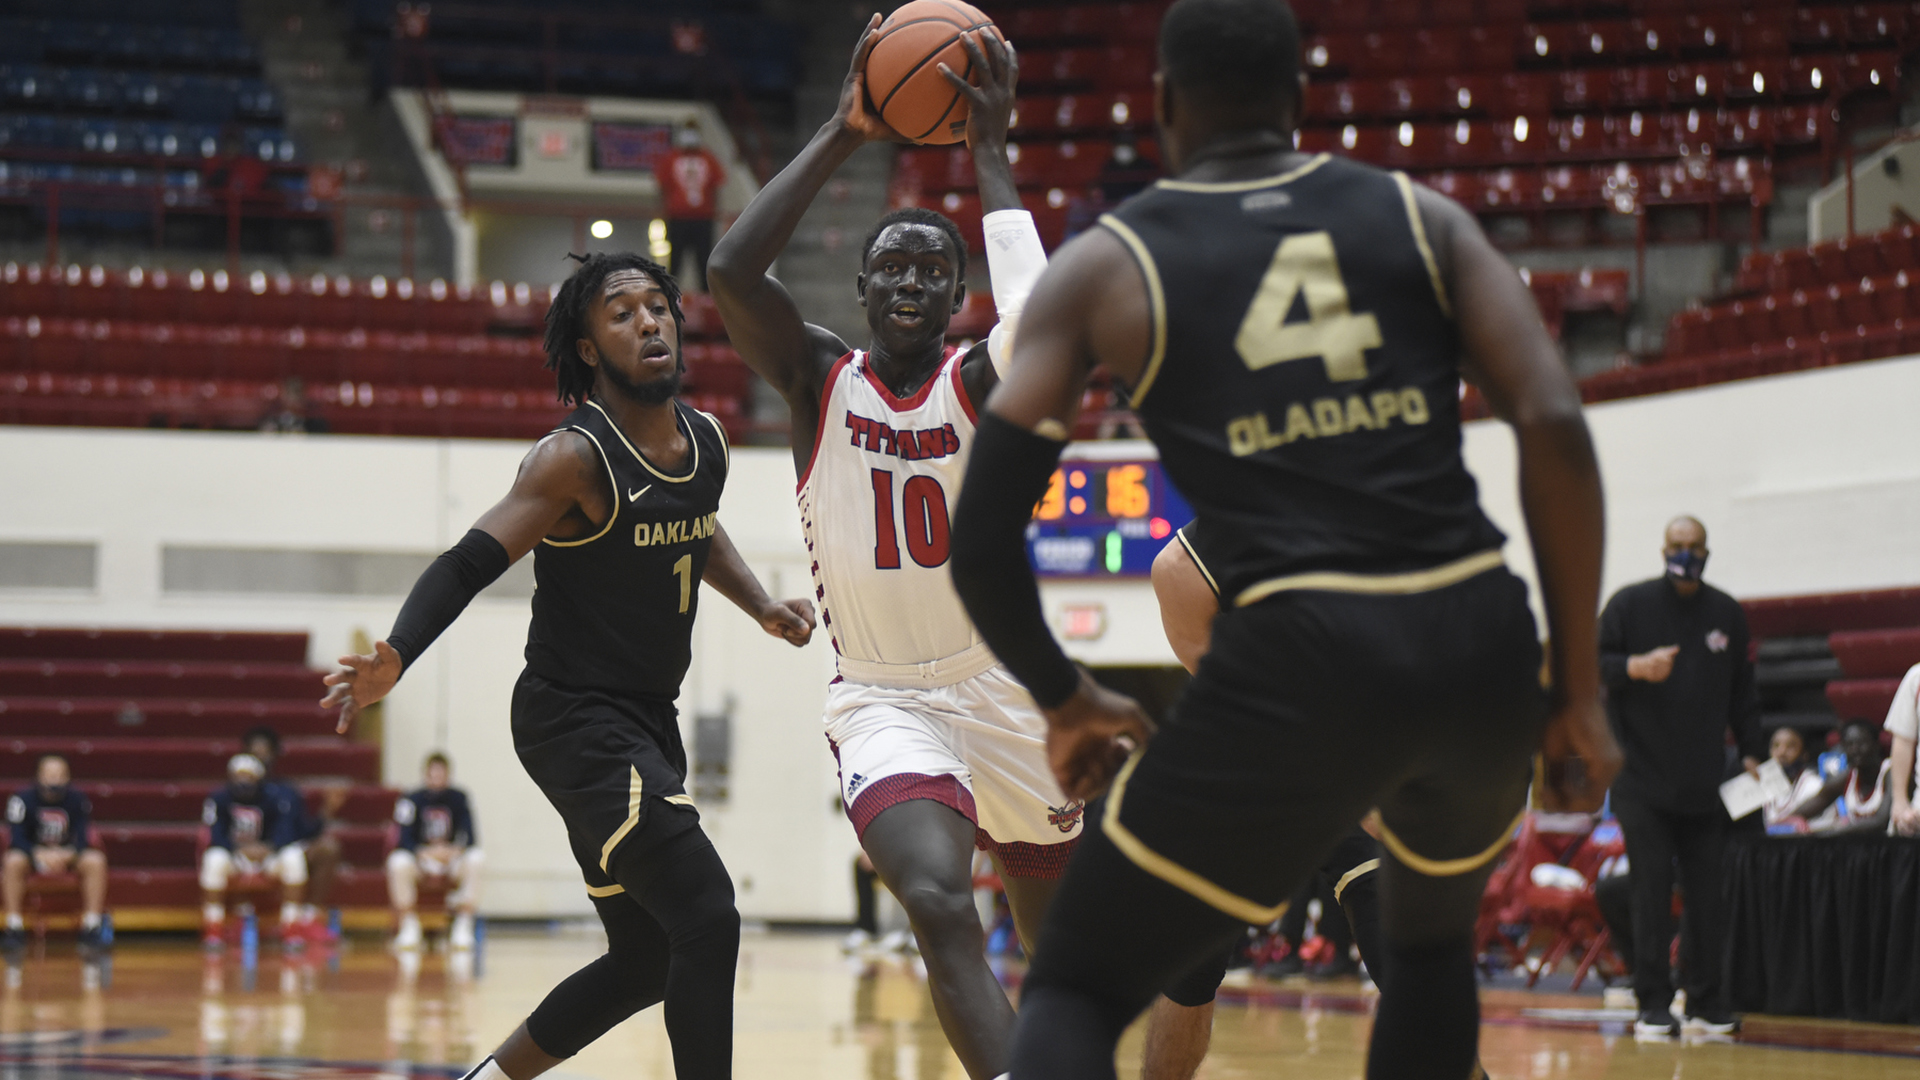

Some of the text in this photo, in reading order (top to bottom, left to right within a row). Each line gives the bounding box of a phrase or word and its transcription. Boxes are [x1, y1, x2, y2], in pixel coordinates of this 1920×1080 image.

[1235, 230, 1382, 381] 4
[845, 409, 961, 461] TITANS
[1227, 387, 1429, 456] OLADAPO
[634, 511, 717, 547] OAKLAND
[871, 467, 953, 570] 10
[673, 553, 692, 614] 1
